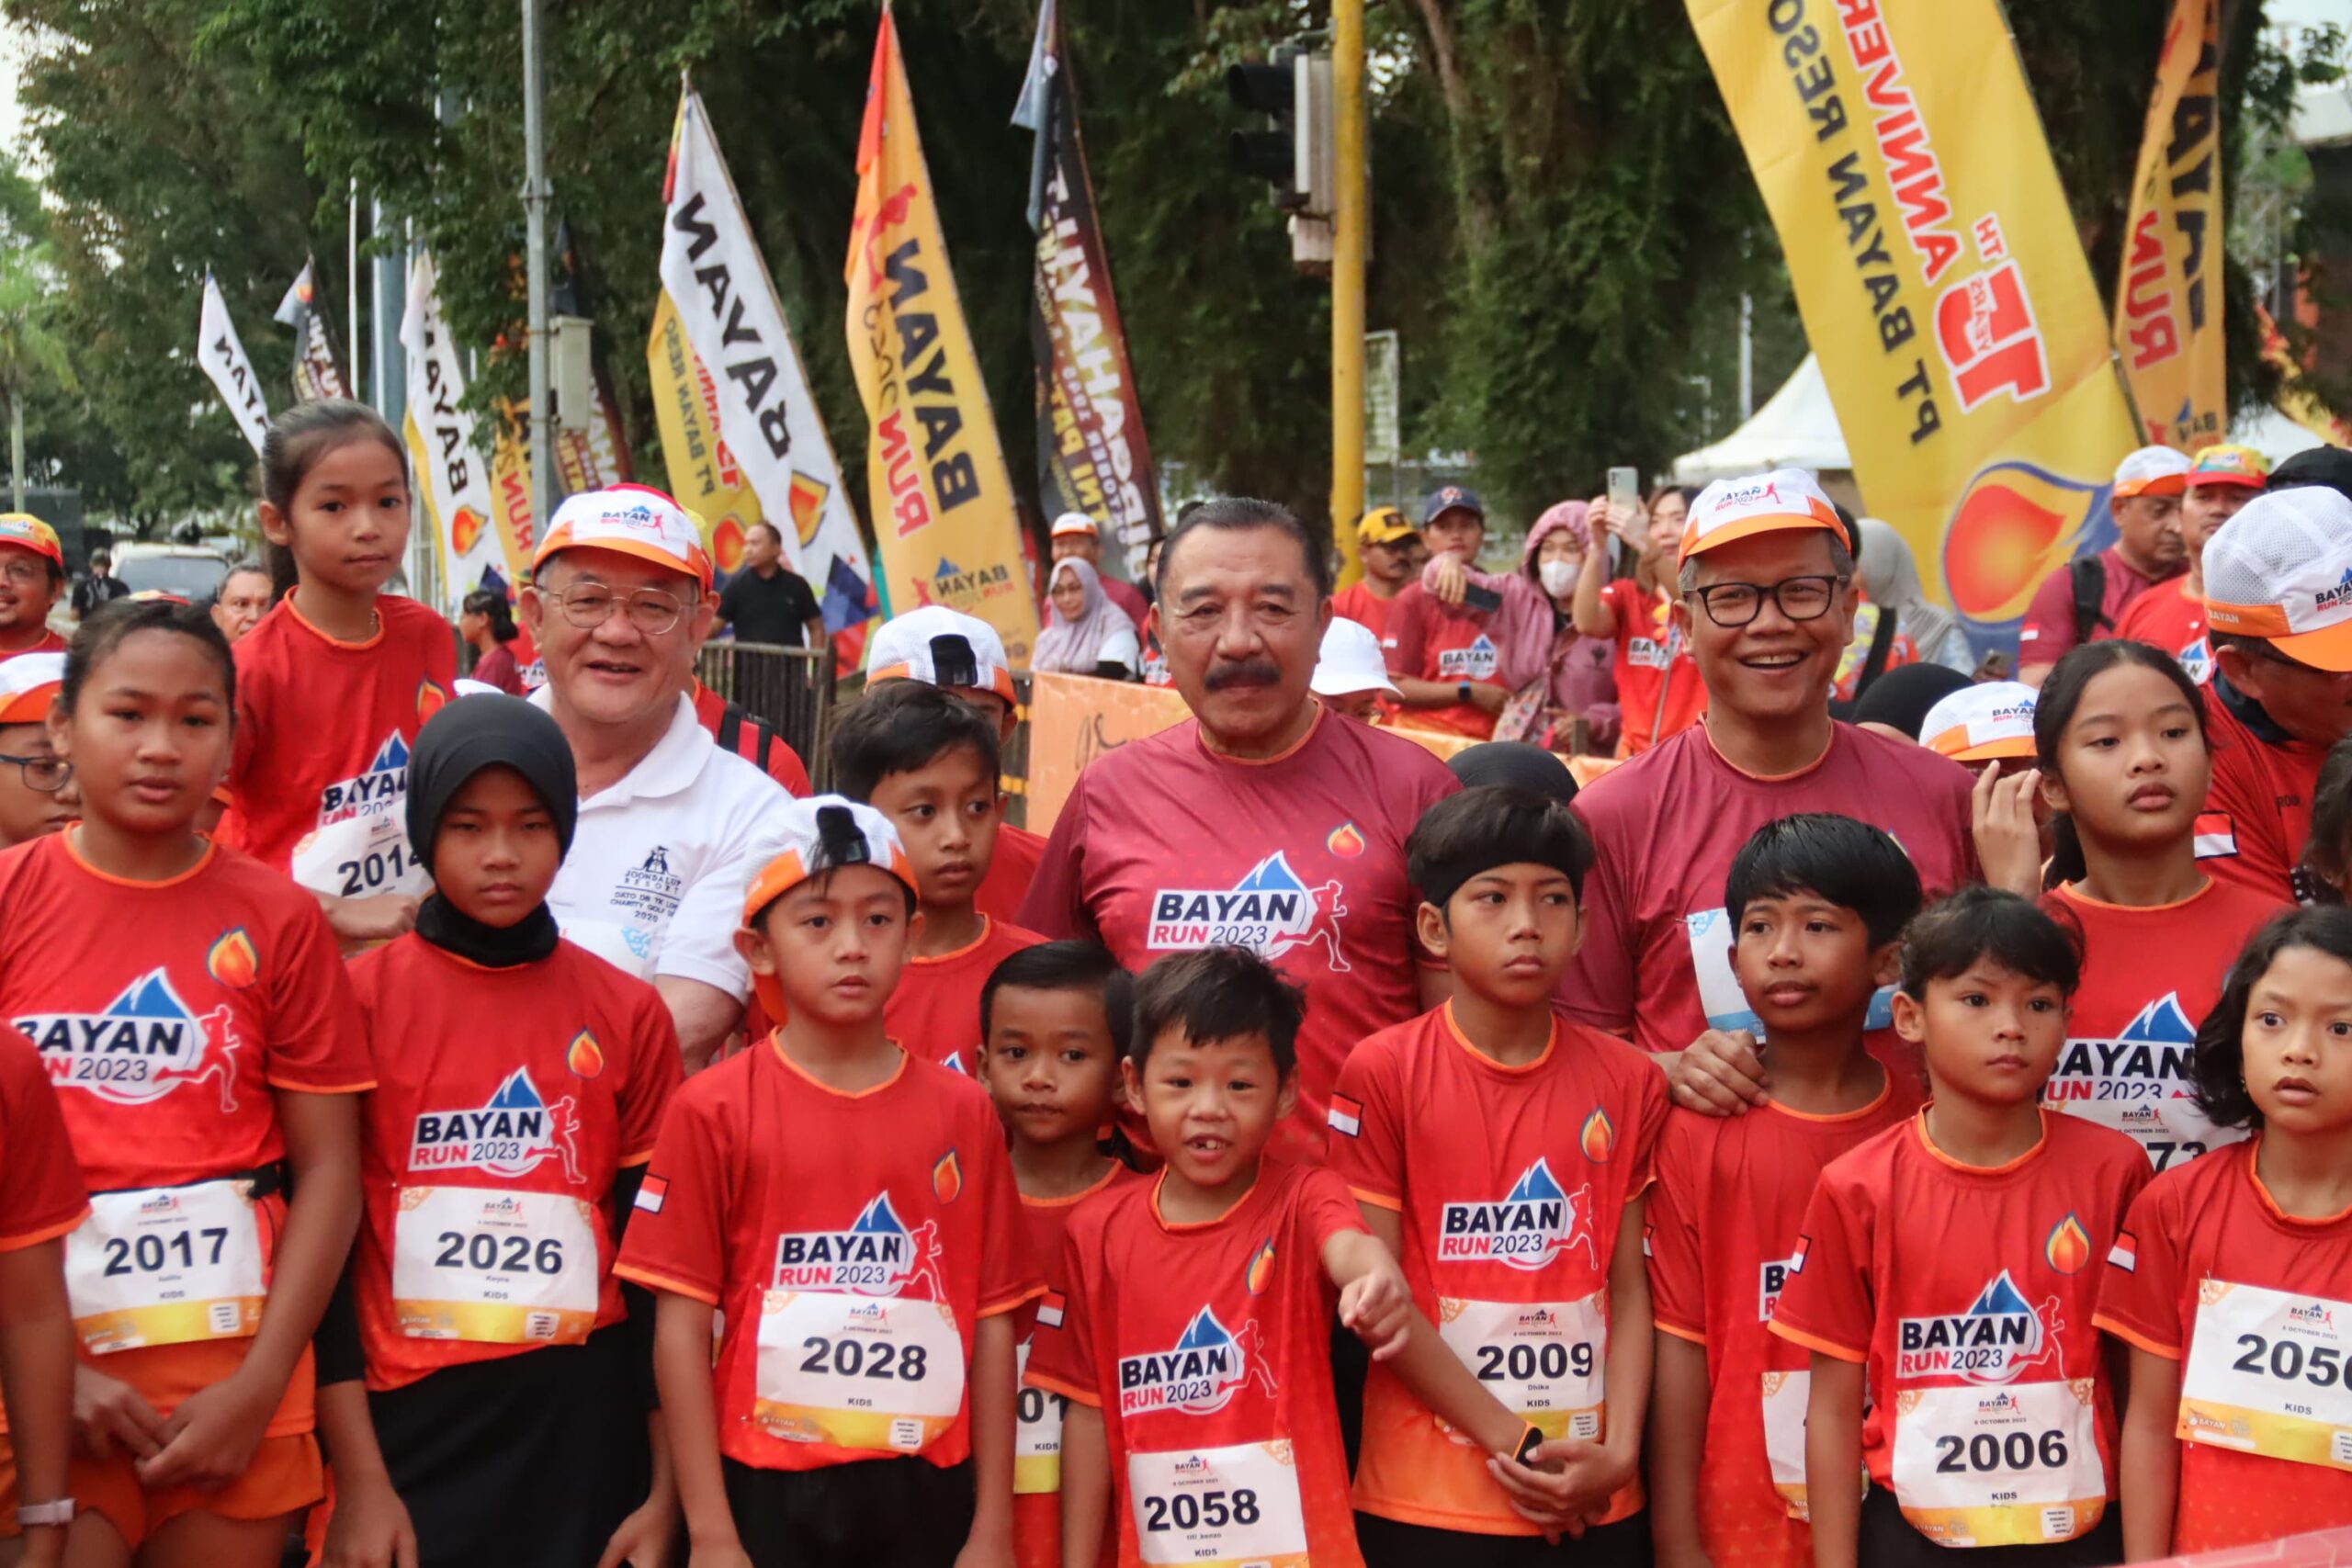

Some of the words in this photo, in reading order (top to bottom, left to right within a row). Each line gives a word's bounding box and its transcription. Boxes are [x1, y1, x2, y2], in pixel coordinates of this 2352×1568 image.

[2317, 599, 2337, 612] RUN
[1443, 651, 1493, 664] BAYAN
[1157, 894, 1297, 921] BAYAN
[1153, 926, 1208, 943] RUN
[1210, 926, 1267, 944] 2023
[76, 1058, 148, 1081] 2023
[2058, 1043, 2193, 1080] AYAN
[2047, 1080, 2092, 1100] UN
[417, 1111, 542, 1144] BAYAN
[414, 1145, 469, 1166] RUN
[470, 1142, 520, 1161] 2023
[1446, 1201, 1561, 1235] BAYAN
[104, 1227, 229, 1277] 2017
[435, 1231, 562, 1275] 2026
[783, 1236, 901, 1265] BAYAN
[1442, 1236, 1492, 1256] RUN
[1492, 1234, 1543, 1255] 2023
[779, 1268, 832, 1285] RUN
[835, 1266, 885, 1284] 2023
[483, 1291, 508, 1300] KIDS
[850, 1307, 878, 1316] BAYAN
[2290, 1307, 2323, 1318] BAYAN
[1903, 1315, 2028, 1350] BAYAN
[2289, 1326, 2320, 1337] OCTOBER
[799, 1337, 928, 1382] 2028
[1122, 1347, 1227, 1389] BAYAN
[1477, 1342, 1592, 1381] 2009
[1901, 1351, 1950, 1373] RUN
[1951, 1348, 2003, 1370] 2023
[2233, 1333, 2352, 1392] 205
[848, 1397, 872, 1407] KIDS
[1123, 1386, 1164, 1411] RUN
[1167, 1380, 1212, 1404] 2023
[1527, 1399, 1550, 1408] KIDS
[1979, 1399, 2008, 1407] BAYAN
[2285, 1403, 2312, 1415] KIDS
[1035, 1441, 1059, 1451] KIDS
[1936, 1429, 2068, 1473] 2006
[1175, 1461, 1201, 1471] BAYAN
[1992, 1492, 2018, 1501] KIDS
[1144, 1489, 1260, 1532] 2058
[1194, 1548, 1217, 1557] KIDS
